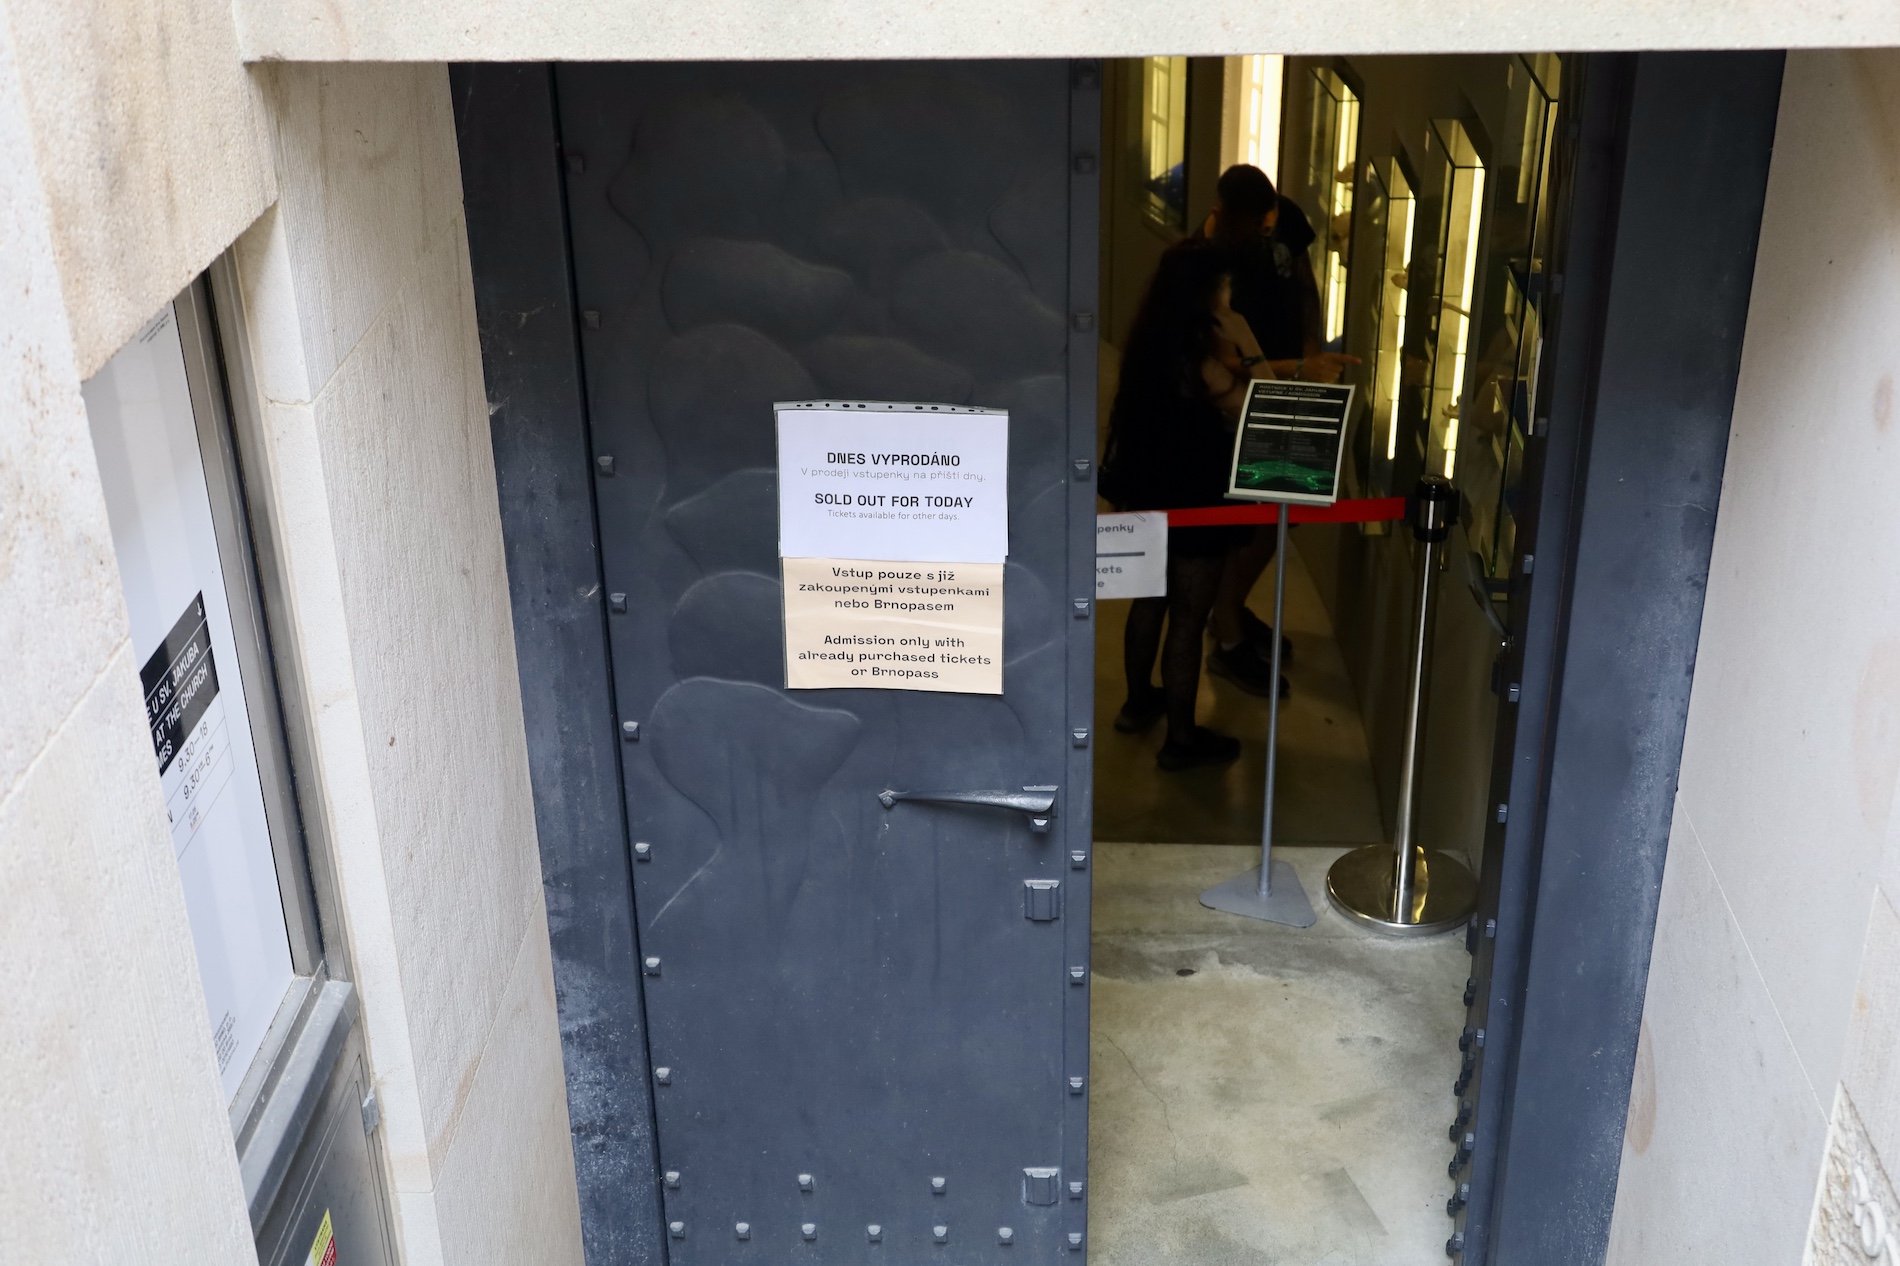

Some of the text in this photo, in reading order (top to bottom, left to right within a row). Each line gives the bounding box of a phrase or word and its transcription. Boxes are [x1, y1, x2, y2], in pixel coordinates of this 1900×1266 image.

[828, 452, 960, 466] DNES VYPRODÁNO
[812, 469, 849, 479] prodeji
[853, 470, 909, 480] vstupenky
[963, 473, 985, 482] dny.
[815, 493, 973, 507] SOLD OUT FOR TODAY
[828, 510, 856, 518] Tickets
[939, 512, 959, 521] days.
[833, 568, 873, 579] Vstup
[879, 572, 921, 580] pouze
[938, 571, 954, 582] již
[800, 583, 989, 596] zakoupenými vstupenkami
[835, 599, 953, 612] nebo Brnopasem
[825, 635, 964, 648] Admission only with
[799, 651, 990, 664] already purchased tickets
[152, 641, 199, 714] U SV. JAKUBA
[873, 667, 938, 679] Brnopass
[155, 662, 208, 747] AT THE CHURCH
